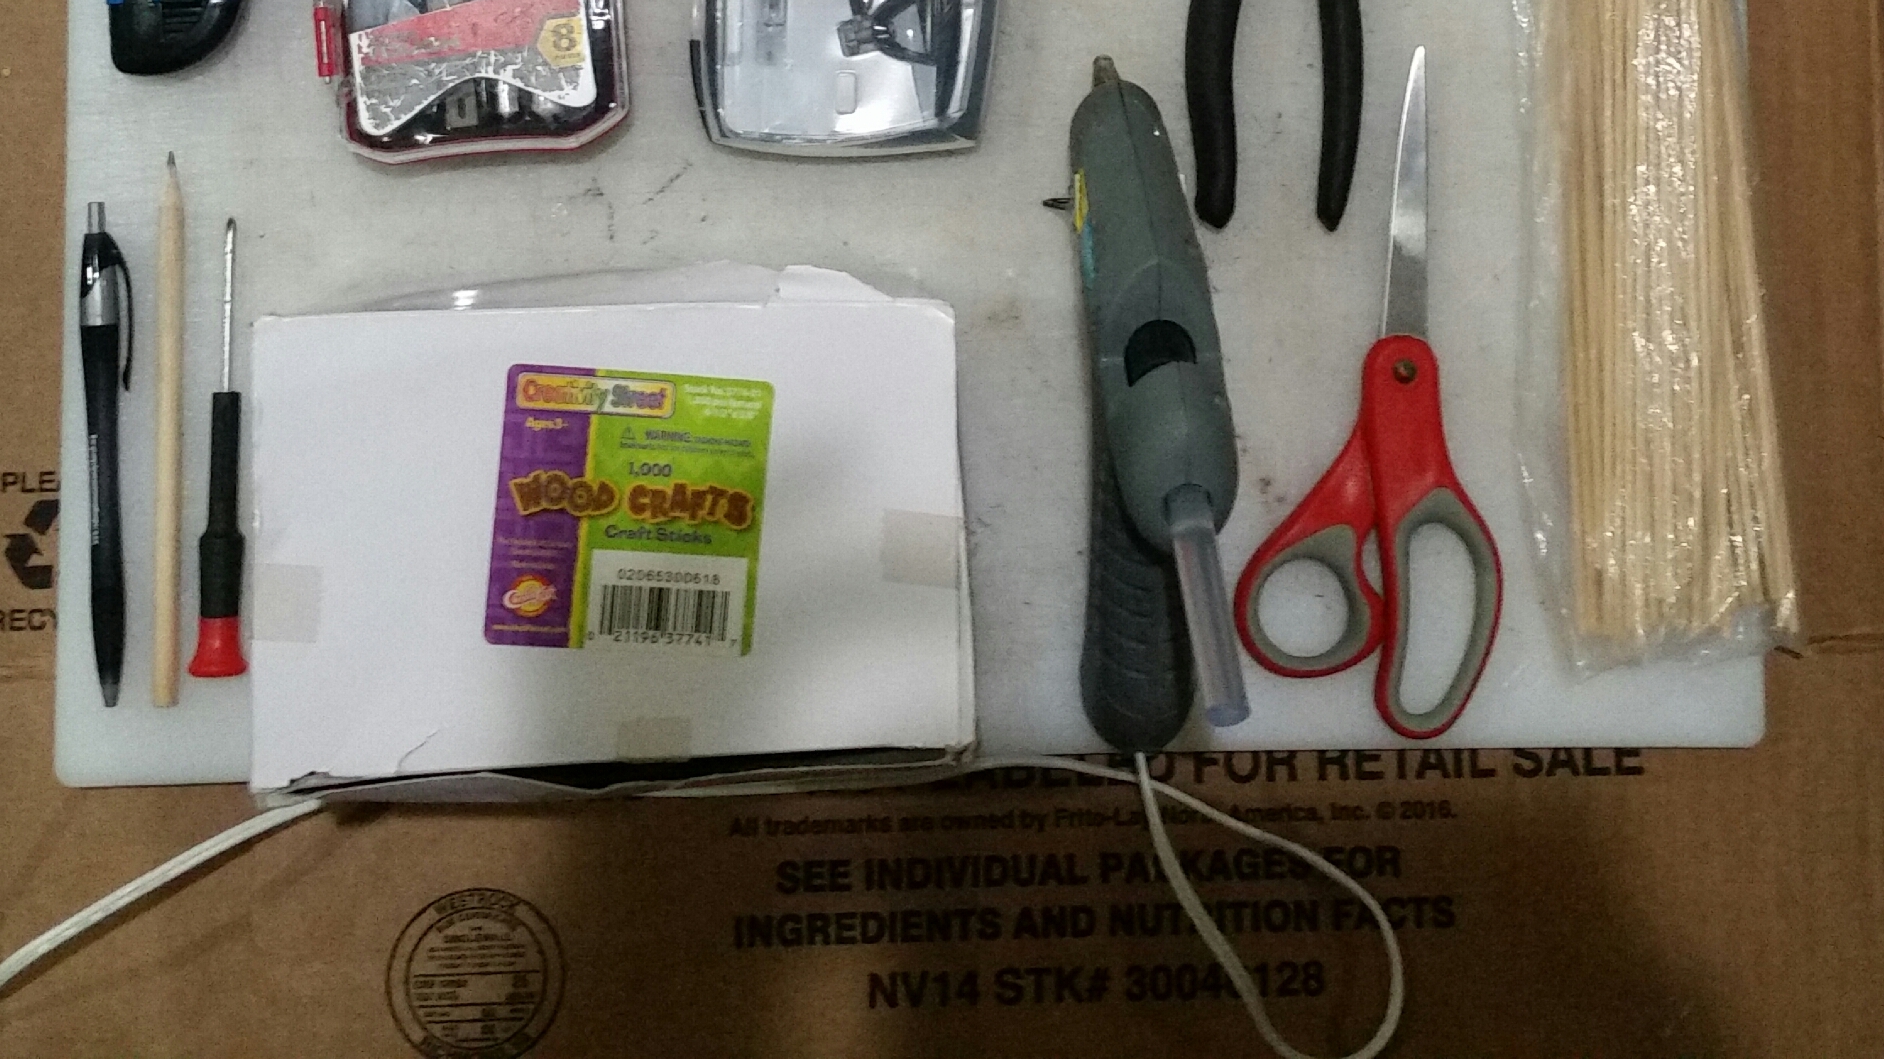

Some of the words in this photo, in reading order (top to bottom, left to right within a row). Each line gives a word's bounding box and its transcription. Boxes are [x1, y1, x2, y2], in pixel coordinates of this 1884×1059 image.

[551, 24, 578, 53] 8
[2, 471, 61, 493] PLE
[628, 461, 673, 477] 1,000
[511, 471, 618, 516] WOOD
[627, 480, 753, 529] CRAFTS
[605, 525, 652, 540] Craft
[657, 526, 713, 545] Sticks
[1191, 750, 1299, 784] FOR
[1316, 749, 1497, 782] RETAIL
[1512, 748, 1645, 780] SALE
[729, 815, 758, 837] All
[764, 814, 892, 836] trademarks
[898, 815, 935, 833] are
[941, 810, 1014, 832] owned
[1021, 809, 1046, 832] by
[1331, 802, 1371, 821] Inc.
[1399, 800, 1458, 821] 2016.
[776, 859, 853, 894] SEE
[865, 853, 1089, 891] INDIVIDUAL
[1322, 845, 1402, 878] FOR
[734, 907, 1002, 949] INGREDIENTS
[1013, 906, 1096, 941] AND
[1333, 896, 1456, 932] FACTS
[868, 970, 981, 1009] NV14
[995, 966, 1108, 1007] STK#
